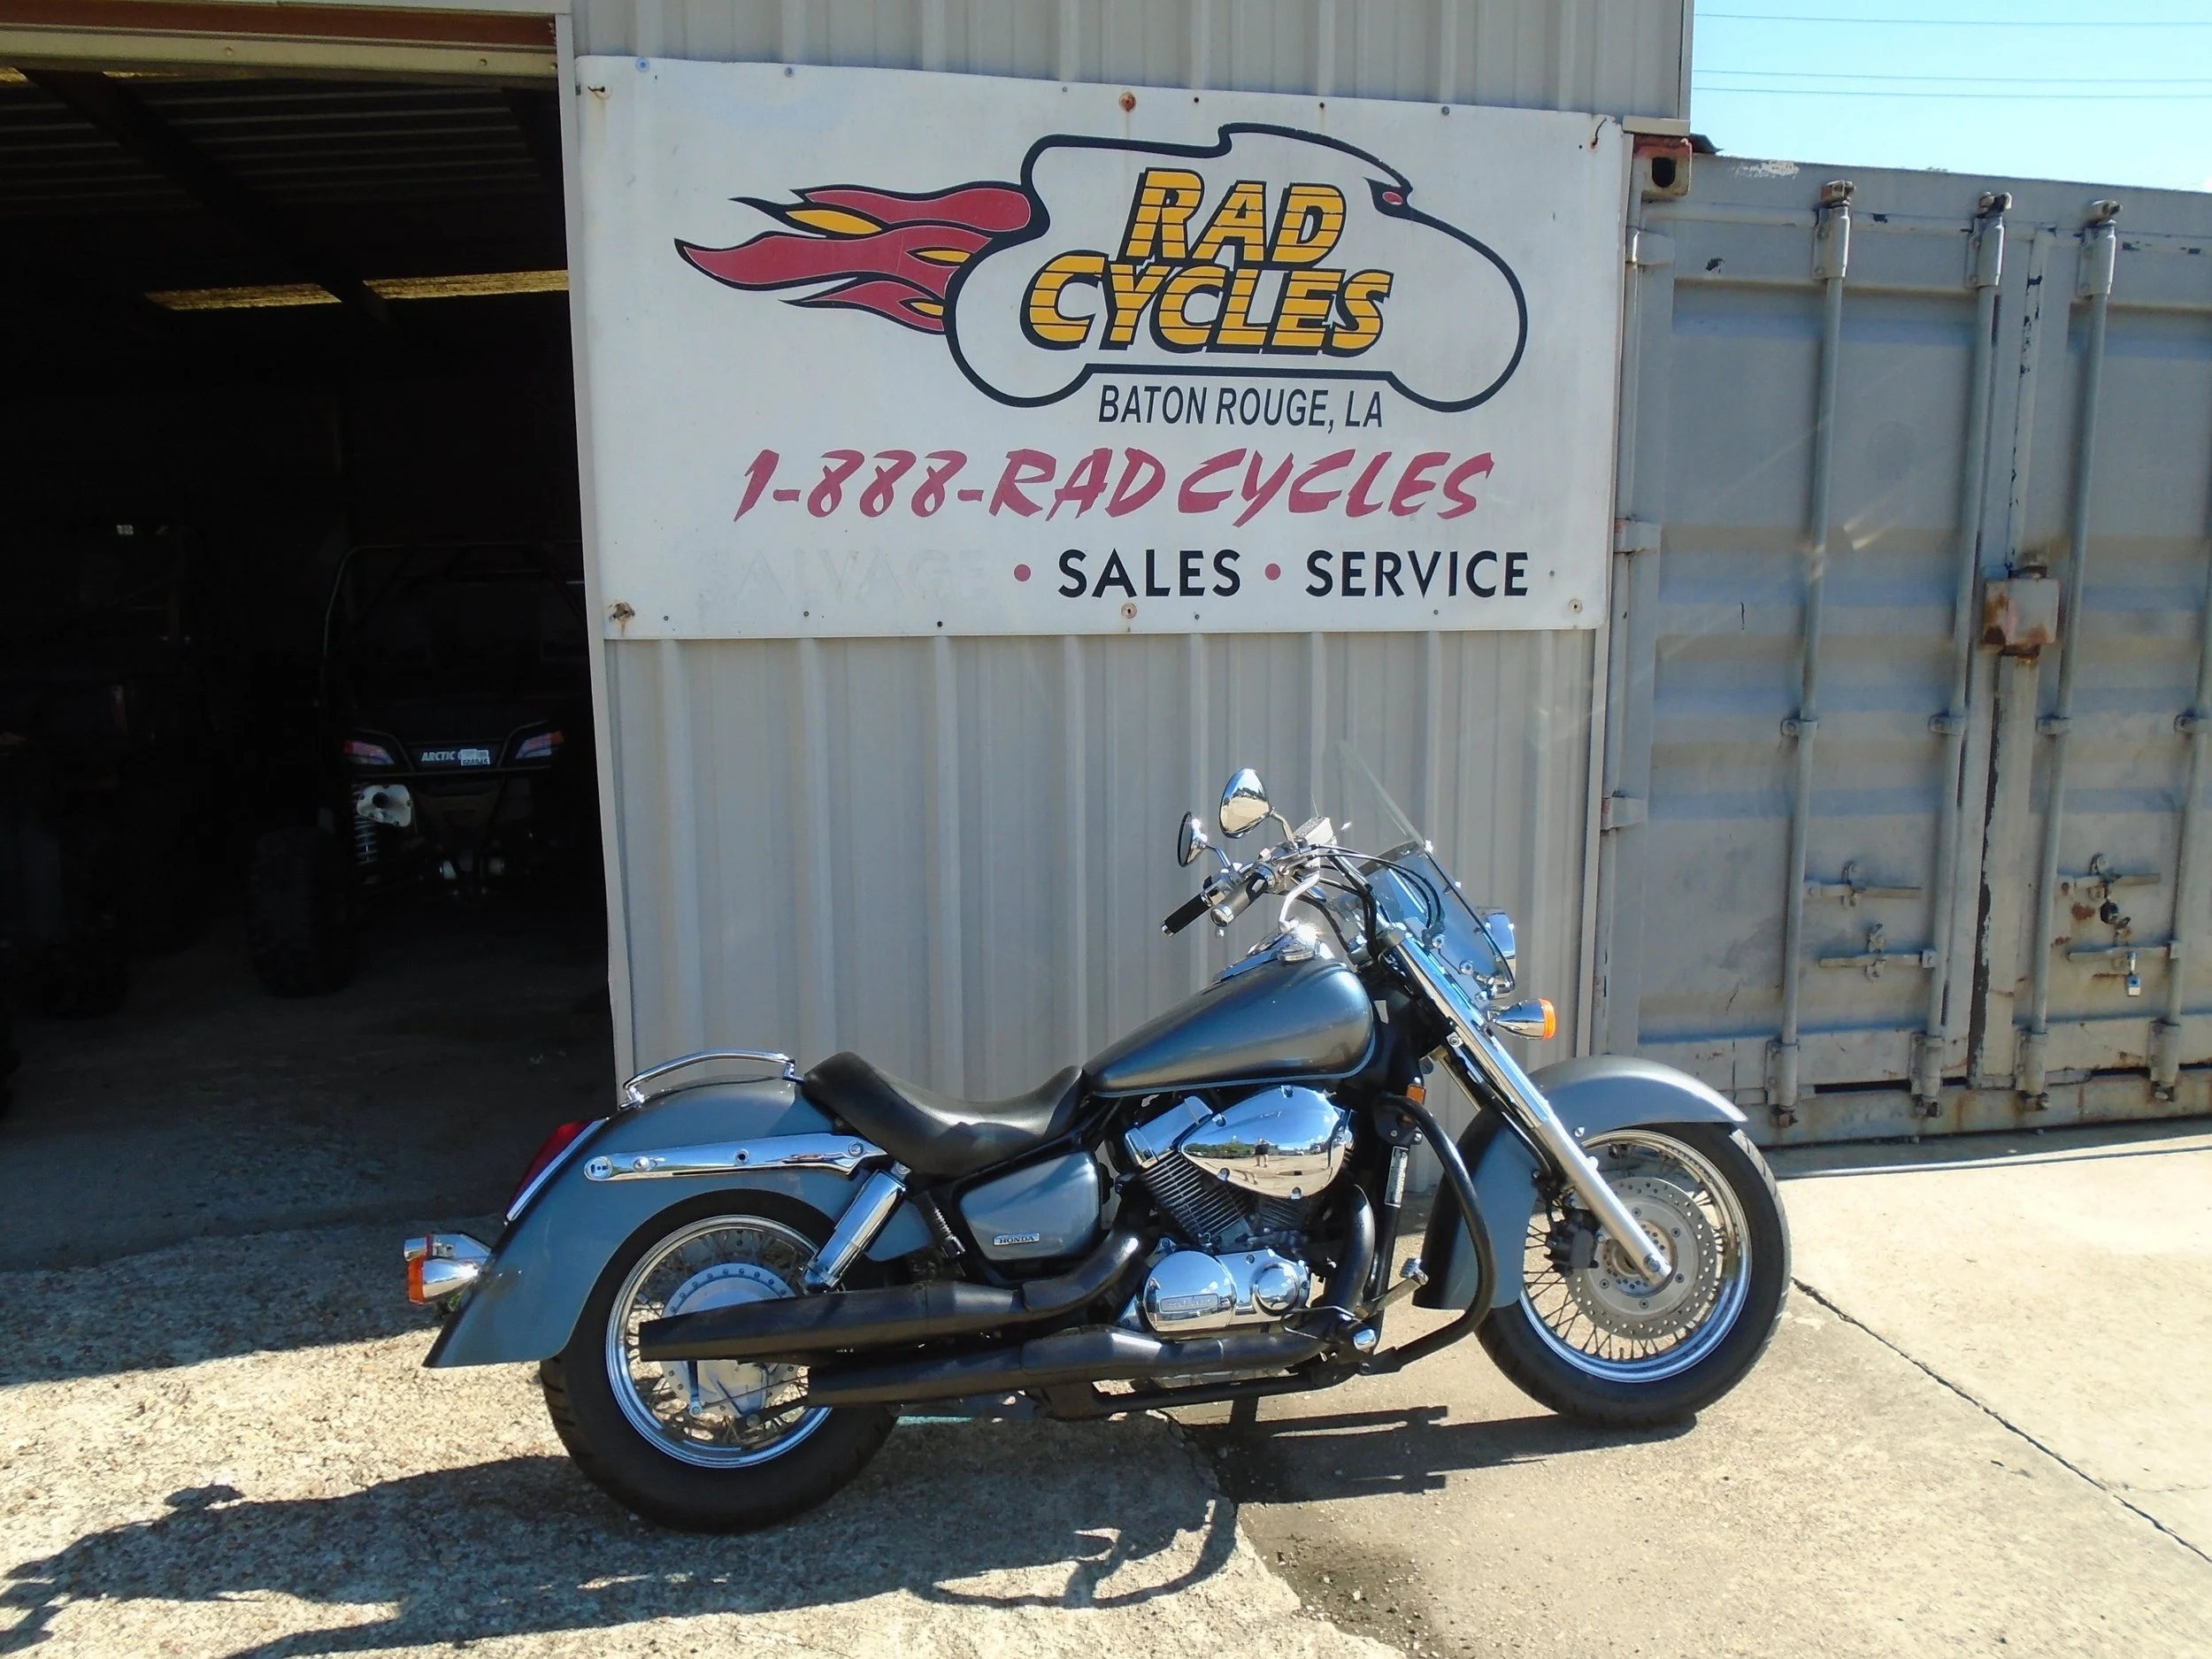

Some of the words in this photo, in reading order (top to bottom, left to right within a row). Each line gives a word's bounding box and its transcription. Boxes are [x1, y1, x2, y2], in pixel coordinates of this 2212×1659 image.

[1111, 167, 1347, 268] RAD
[1020, 250, 1394, 357] CYCLES
[1099, 385, 1211, 426] BATON
[1216, 387, 1333, 434] ROUGE,
[1345, 390, 1383, 428] LA
[733, 447, 1165, 522] 1-888-RAD
[1178, 448, 1494, 527] CYCLES
[695, 547, 987, 602] ALVAGE
[1057, 548, 1241, 598] SALES
[1305, 549, 1528, 599] SERVICE
[421, 751, 456, 761] ARCTIC
